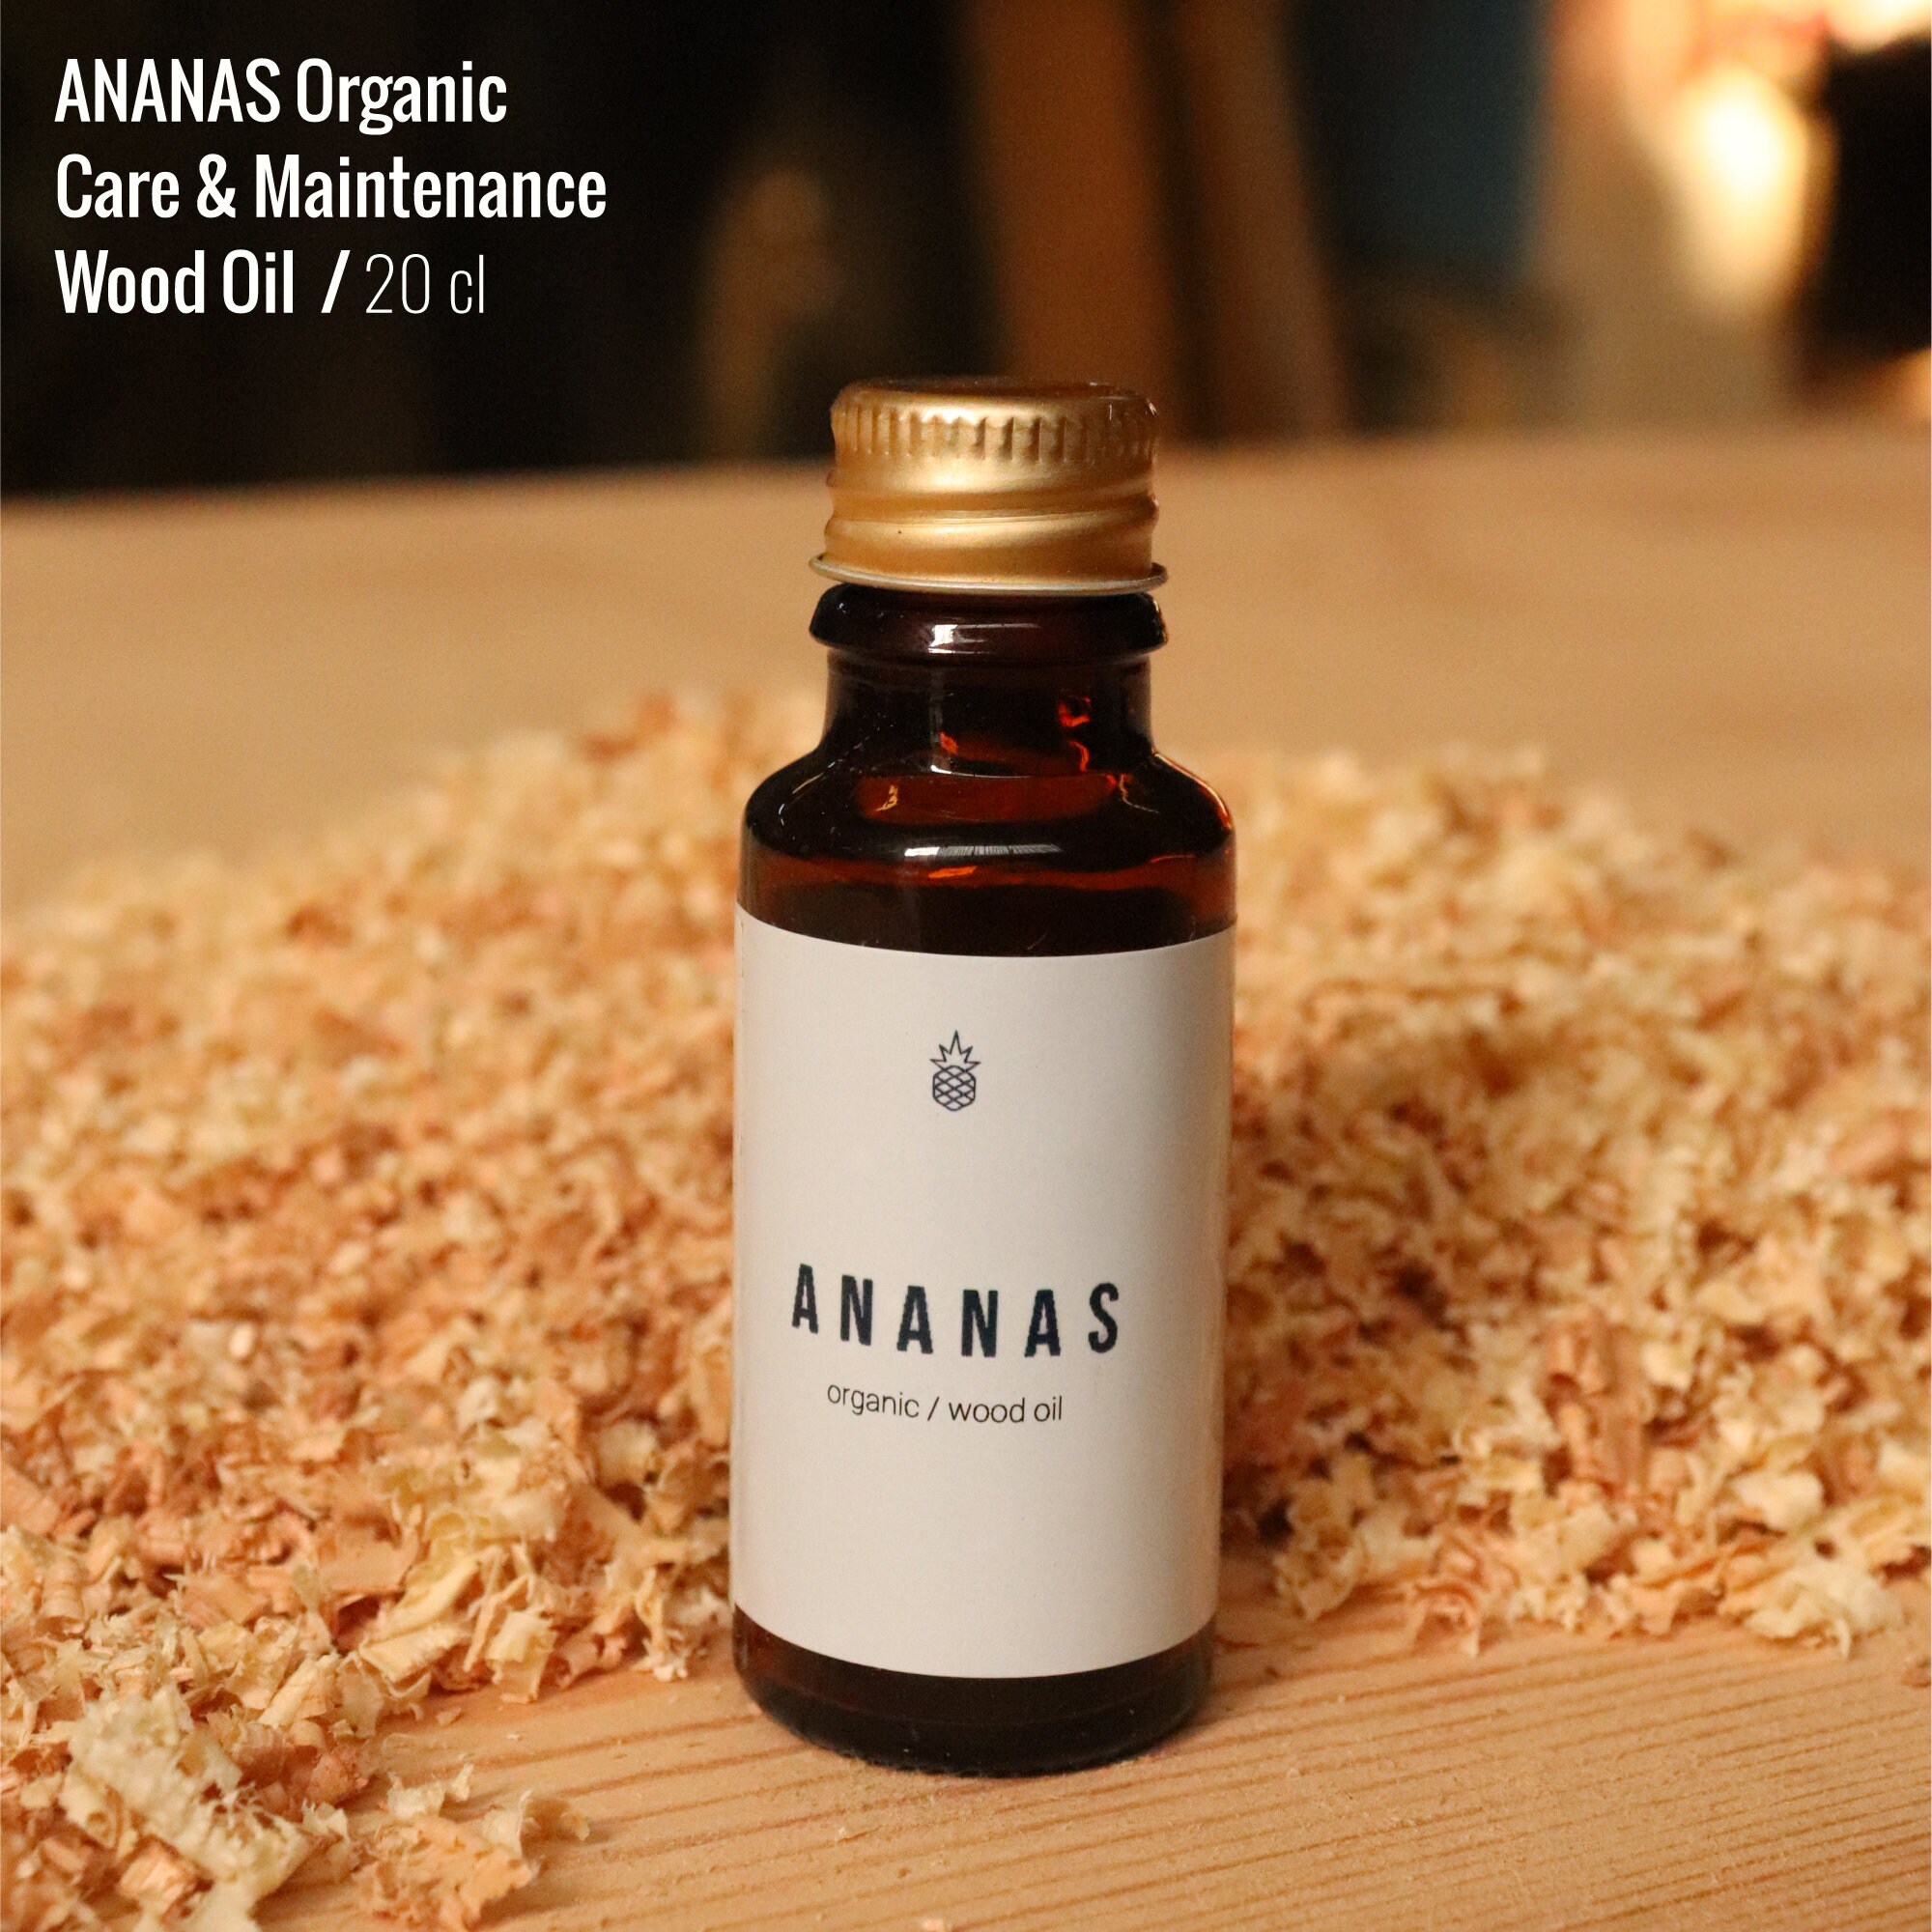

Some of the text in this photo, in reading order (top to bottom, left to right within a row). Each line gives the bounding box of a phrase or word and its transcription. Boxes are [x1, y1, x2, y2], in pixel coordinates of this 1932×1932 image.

[791, 1264, 1120, 1358] ANANAS
[826, 1383, 1064, 1424] organic / wood oil
